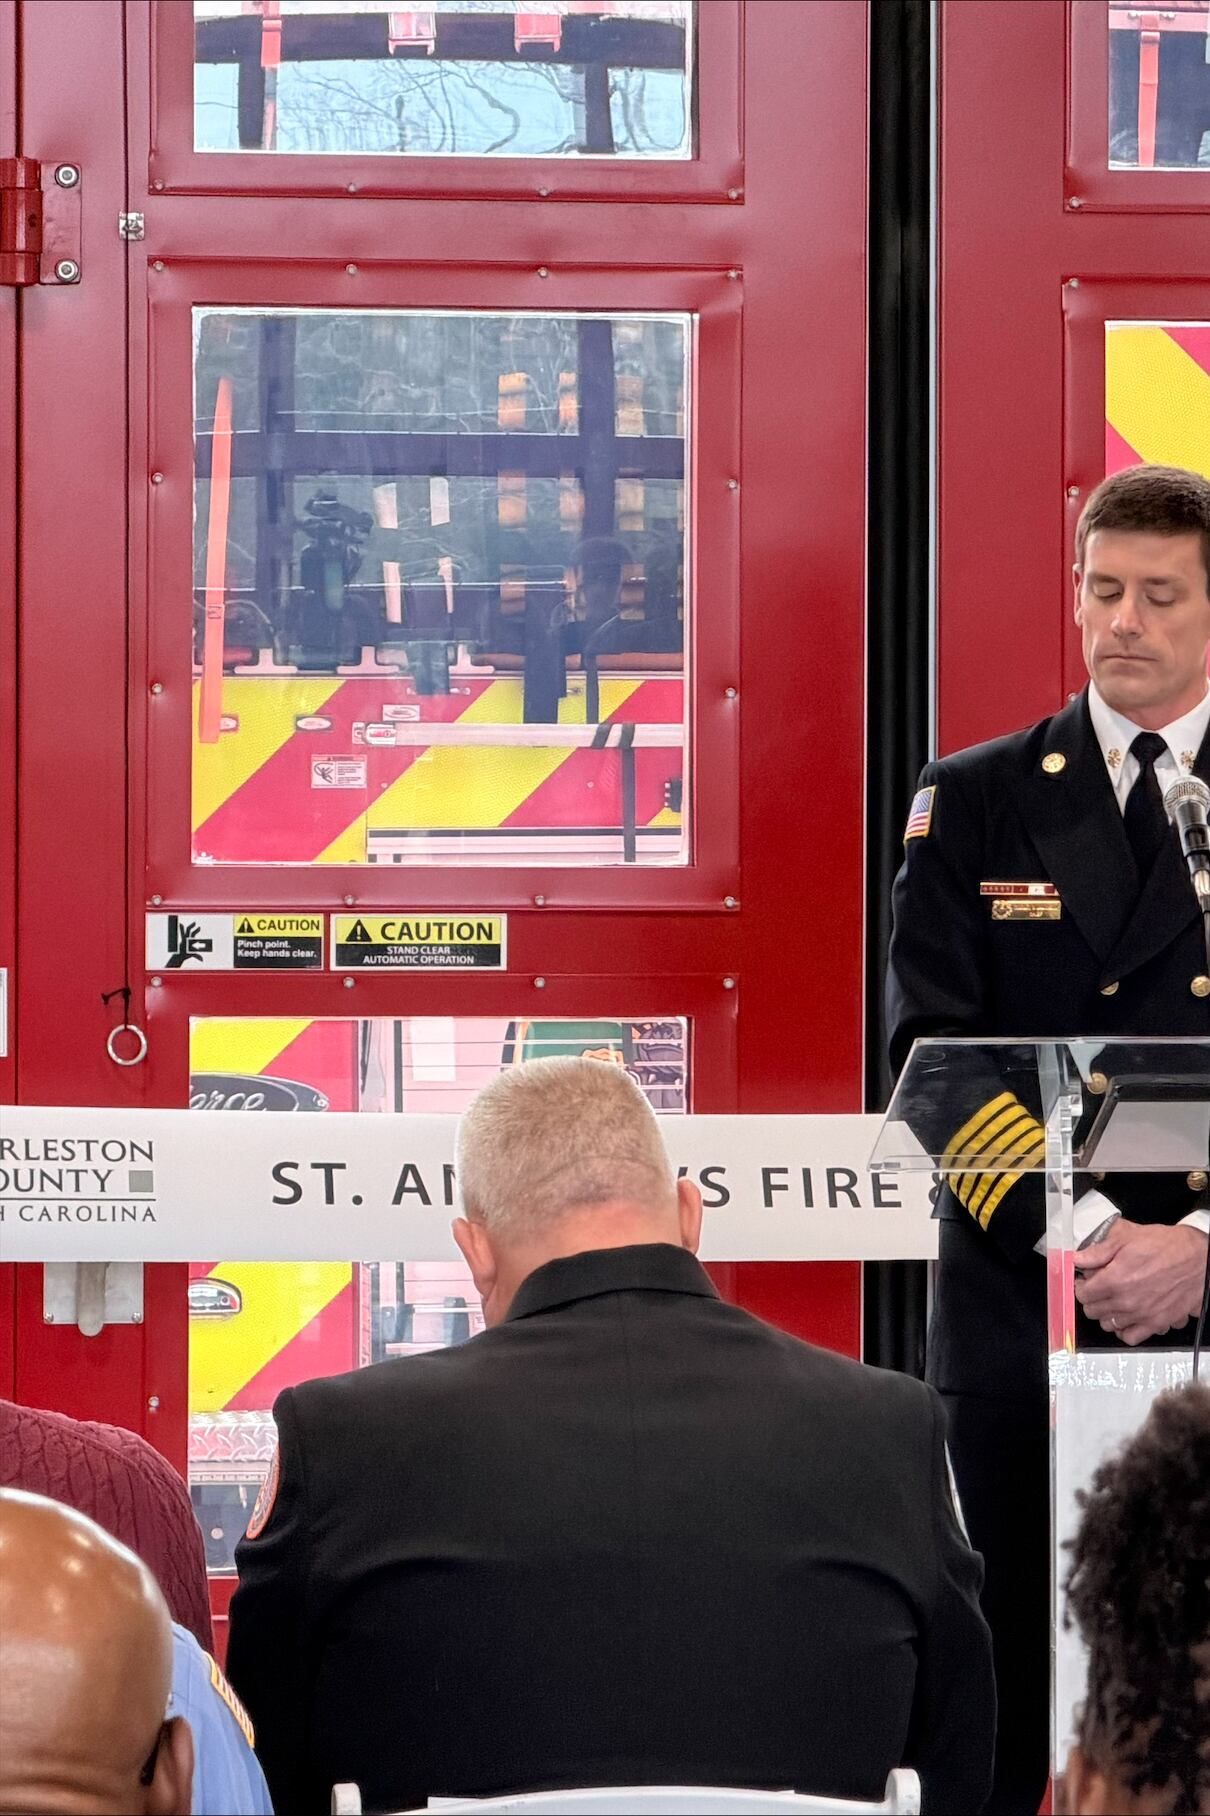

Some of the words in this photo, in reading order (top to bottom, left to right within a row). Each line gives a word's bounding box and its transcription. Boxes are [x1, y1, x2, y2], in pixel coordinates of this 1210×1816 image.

[257, 919, 320, 931] CAUTION
[381, 922, 493, 941] CAUTION
[237, 940, 263, 948] Pinch
[265, 940, 291, 949] point.
[386, 946, 418, 954] STAND
[420, 946, 450, 954] CLEAR
[237, 949, 260, 959] Keep
[262, 949, 290, 957] hands
[292, 949, 317, 957] clear.
[363, 955, 417, 964] AUTOMATIC
[420, 955, 474, 964] OPERATION
[271, 1161, 363, 1206] ST.
[761, 1166, 902, 1208] FIRE
[19, 1205, 156, 1222] CAROLINA
